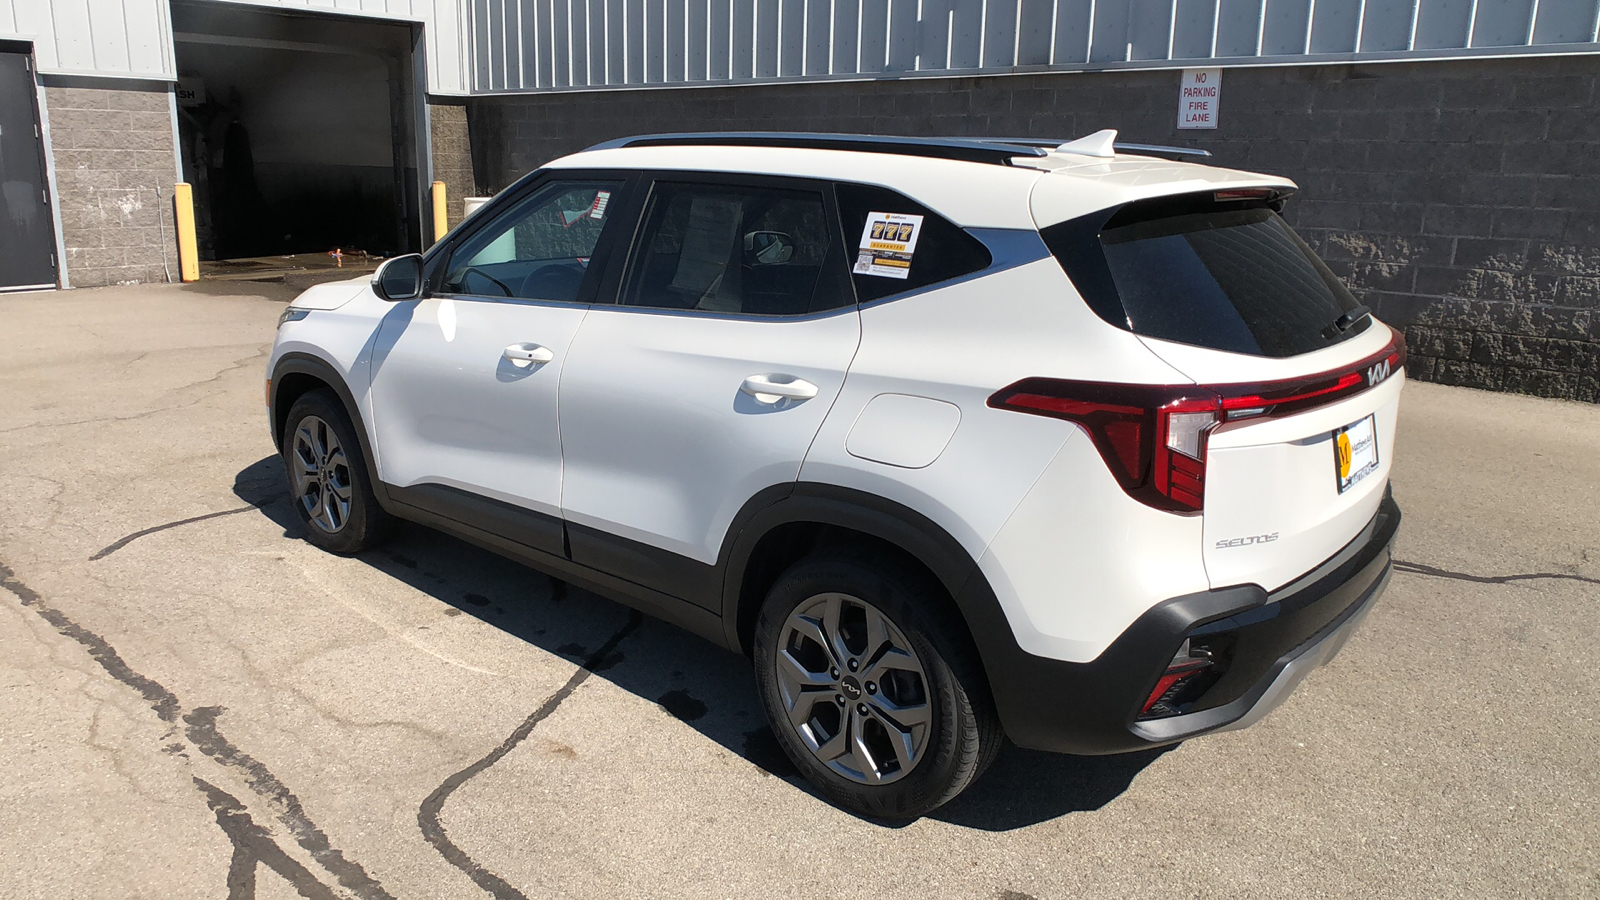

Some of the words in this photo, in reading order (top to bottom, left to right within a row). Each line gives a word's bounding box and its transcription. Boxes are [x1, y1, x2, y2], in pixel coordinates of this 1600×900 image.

[1195, 72, 1207, 83] NO
[178, 90, 195, 99] SH
[1183, 86, 1216, 98] PARKING
[1188, 101, 1208, 111] FIRE
[1185, 113, 1210, 122] LANE
[1215, 531, 1279, 549] SELTOS
